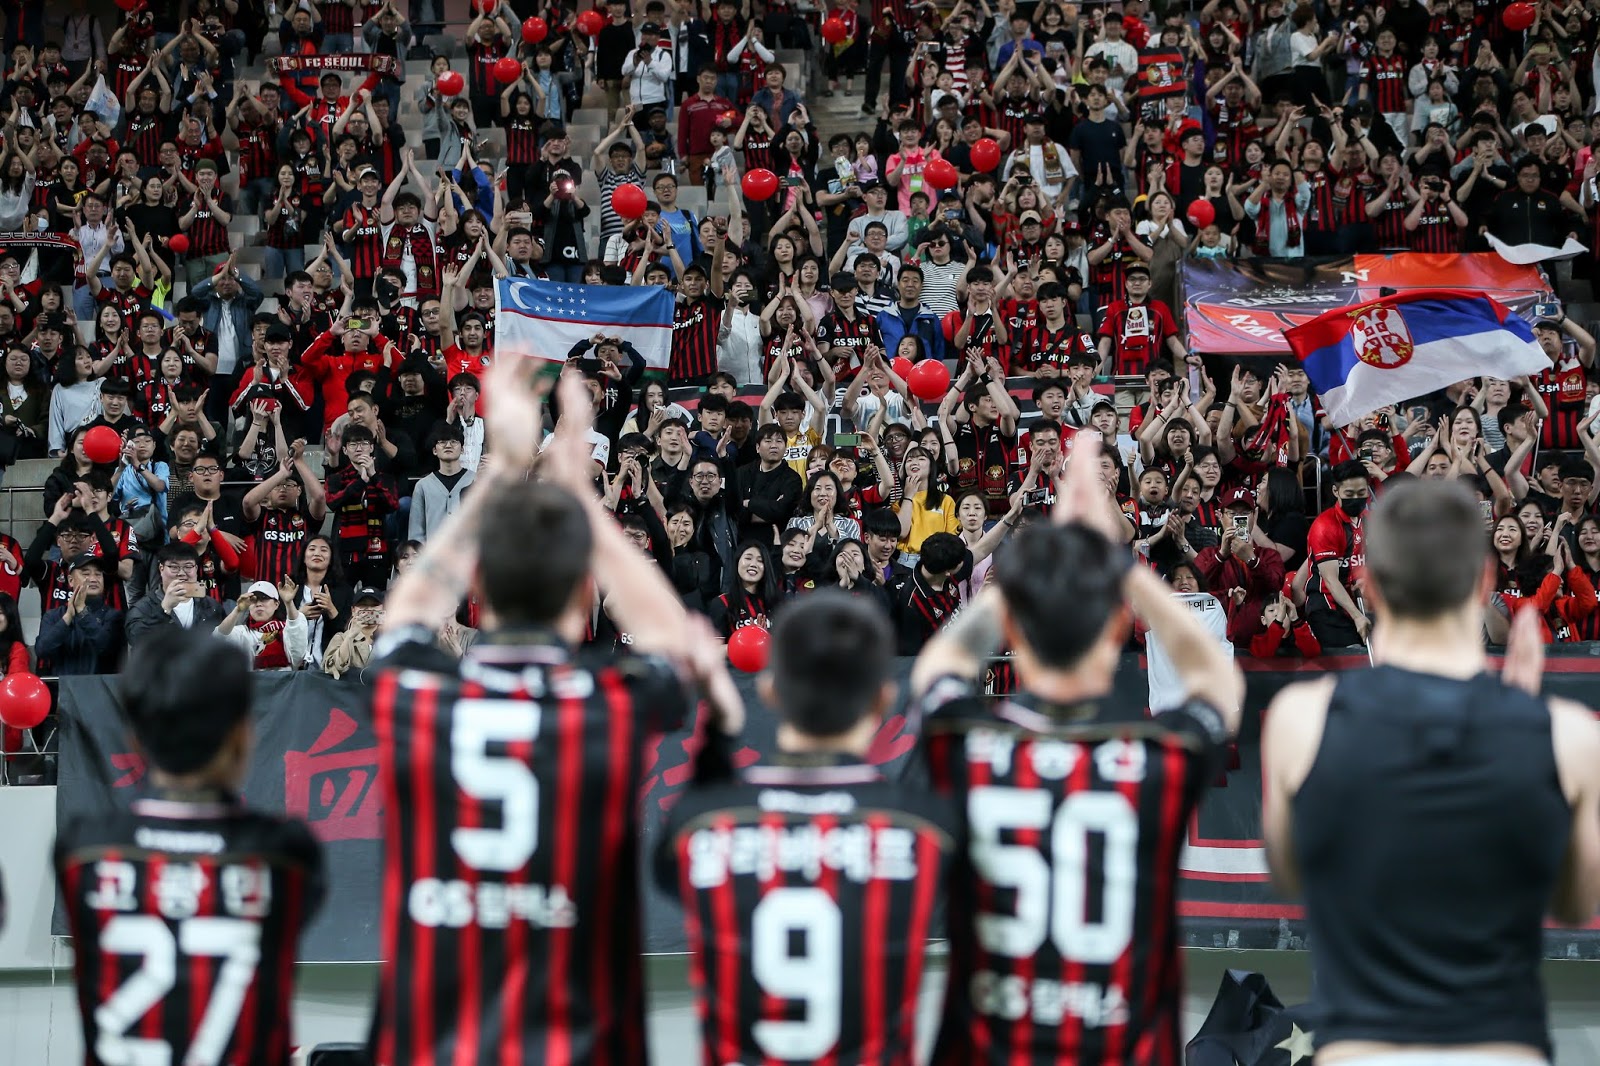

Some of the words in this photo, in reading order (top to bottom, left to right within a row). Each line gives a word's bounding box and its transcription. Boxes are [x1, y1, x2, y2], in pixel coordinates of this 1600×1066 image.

[305, 58, 321, 68] FC
[324, 57, 365, 68] SEOUL
[0, 231, 61, 241] SEOUL
[457, 252, 468, 261] GS
[1126, 318, 1145, 330] Seoul
[834, 337, 846, 346] GS
[847, 337, 871, 347] SHOP
[770, 346, 781, 356] GS
[1031, 353, 1042, 363] GS
[152, 403, 165, 413] GS
[1234, 490, 1245, 499] N
[264, 530, 278, 541] GS
[279, 530, 305, 543] SHOP
[1350, 555, 1366, 568] SH
[53, 588, 67, 600] GS
[621, 632, 634, 645] GS
[450, 697, 543, 872] 5
[966, 785, 1140, 966] 50
[751, 887, 843, 1061] 9
[95, 914, 262, 1066] 27
